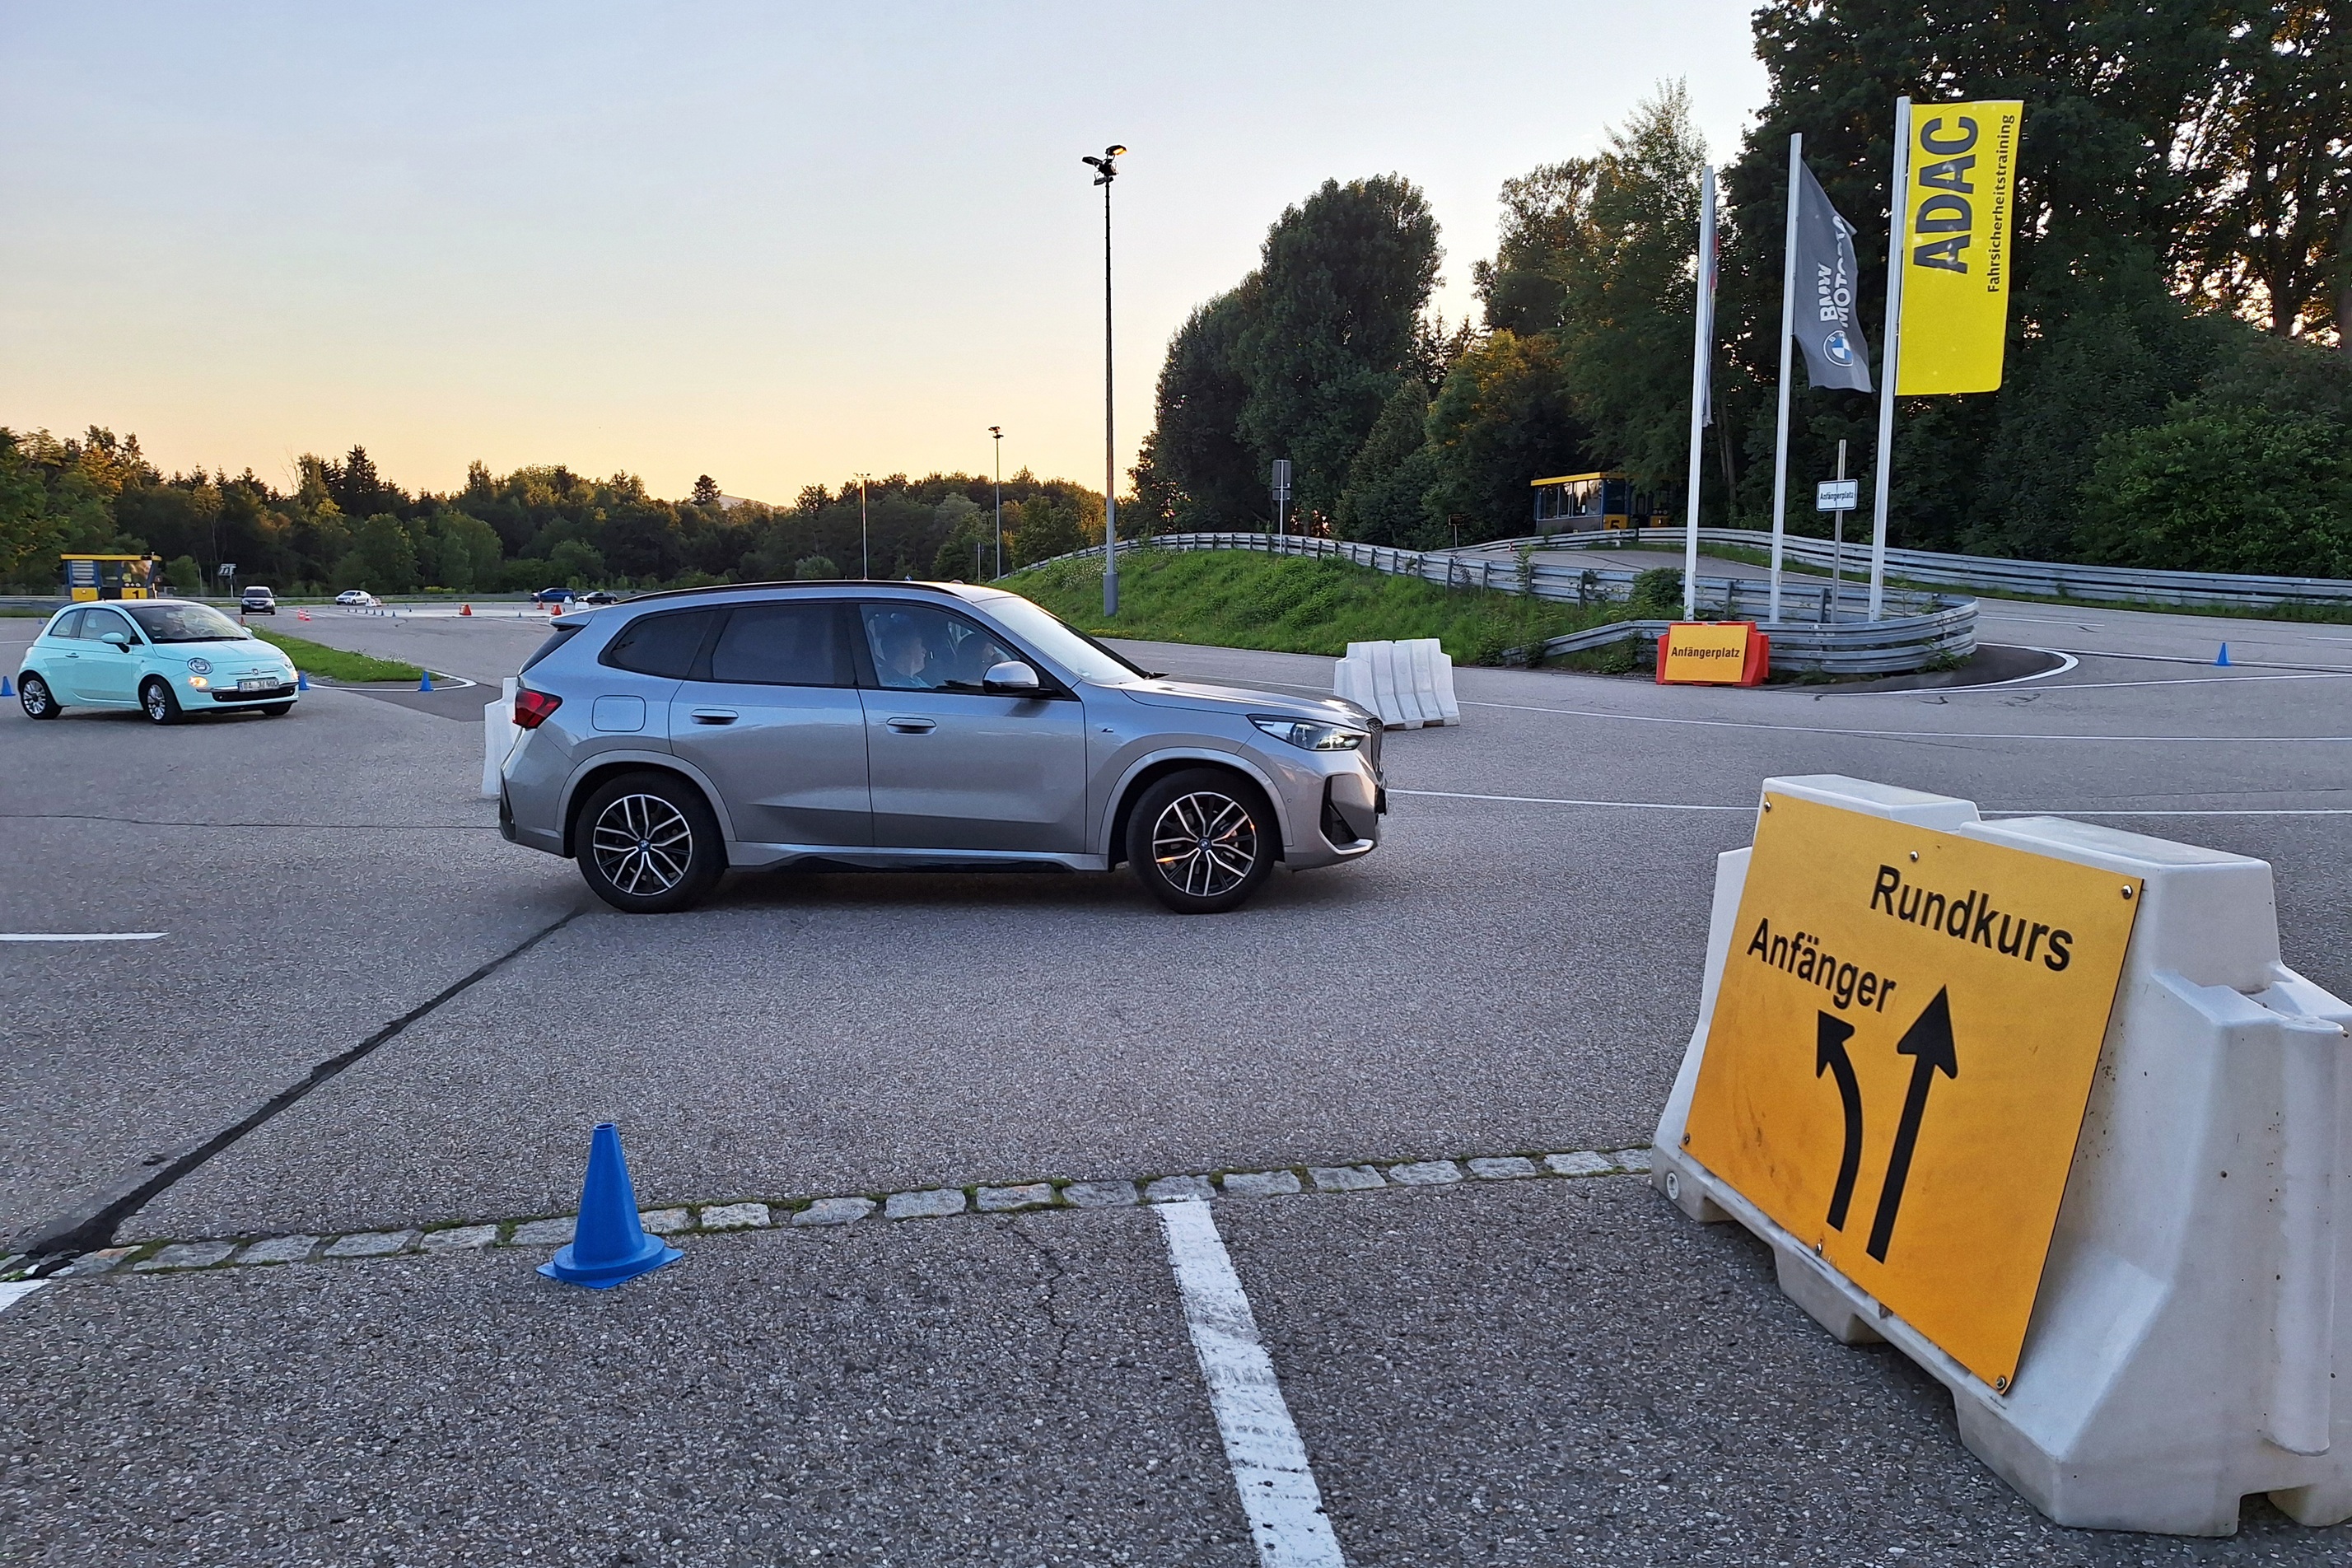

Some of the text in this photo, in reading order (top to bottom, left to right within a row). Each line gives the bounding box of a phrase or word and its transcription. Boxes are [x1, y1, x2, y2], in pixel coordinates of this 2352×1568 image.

[1913, 116, 1978, 274] ADAC
[1987, 114, 2015, 292] Fahrsicherheitstraining
[1818, 262, 1838, 321] BMW
[1820, 492, 1854, 501] Anfängerplatz
[1671, 646, 1740, 660] Anfängerplatz
[1746, 917, 1897, 1013] Anfänger
[1870, 864, 2074, 972] Rundkurs
